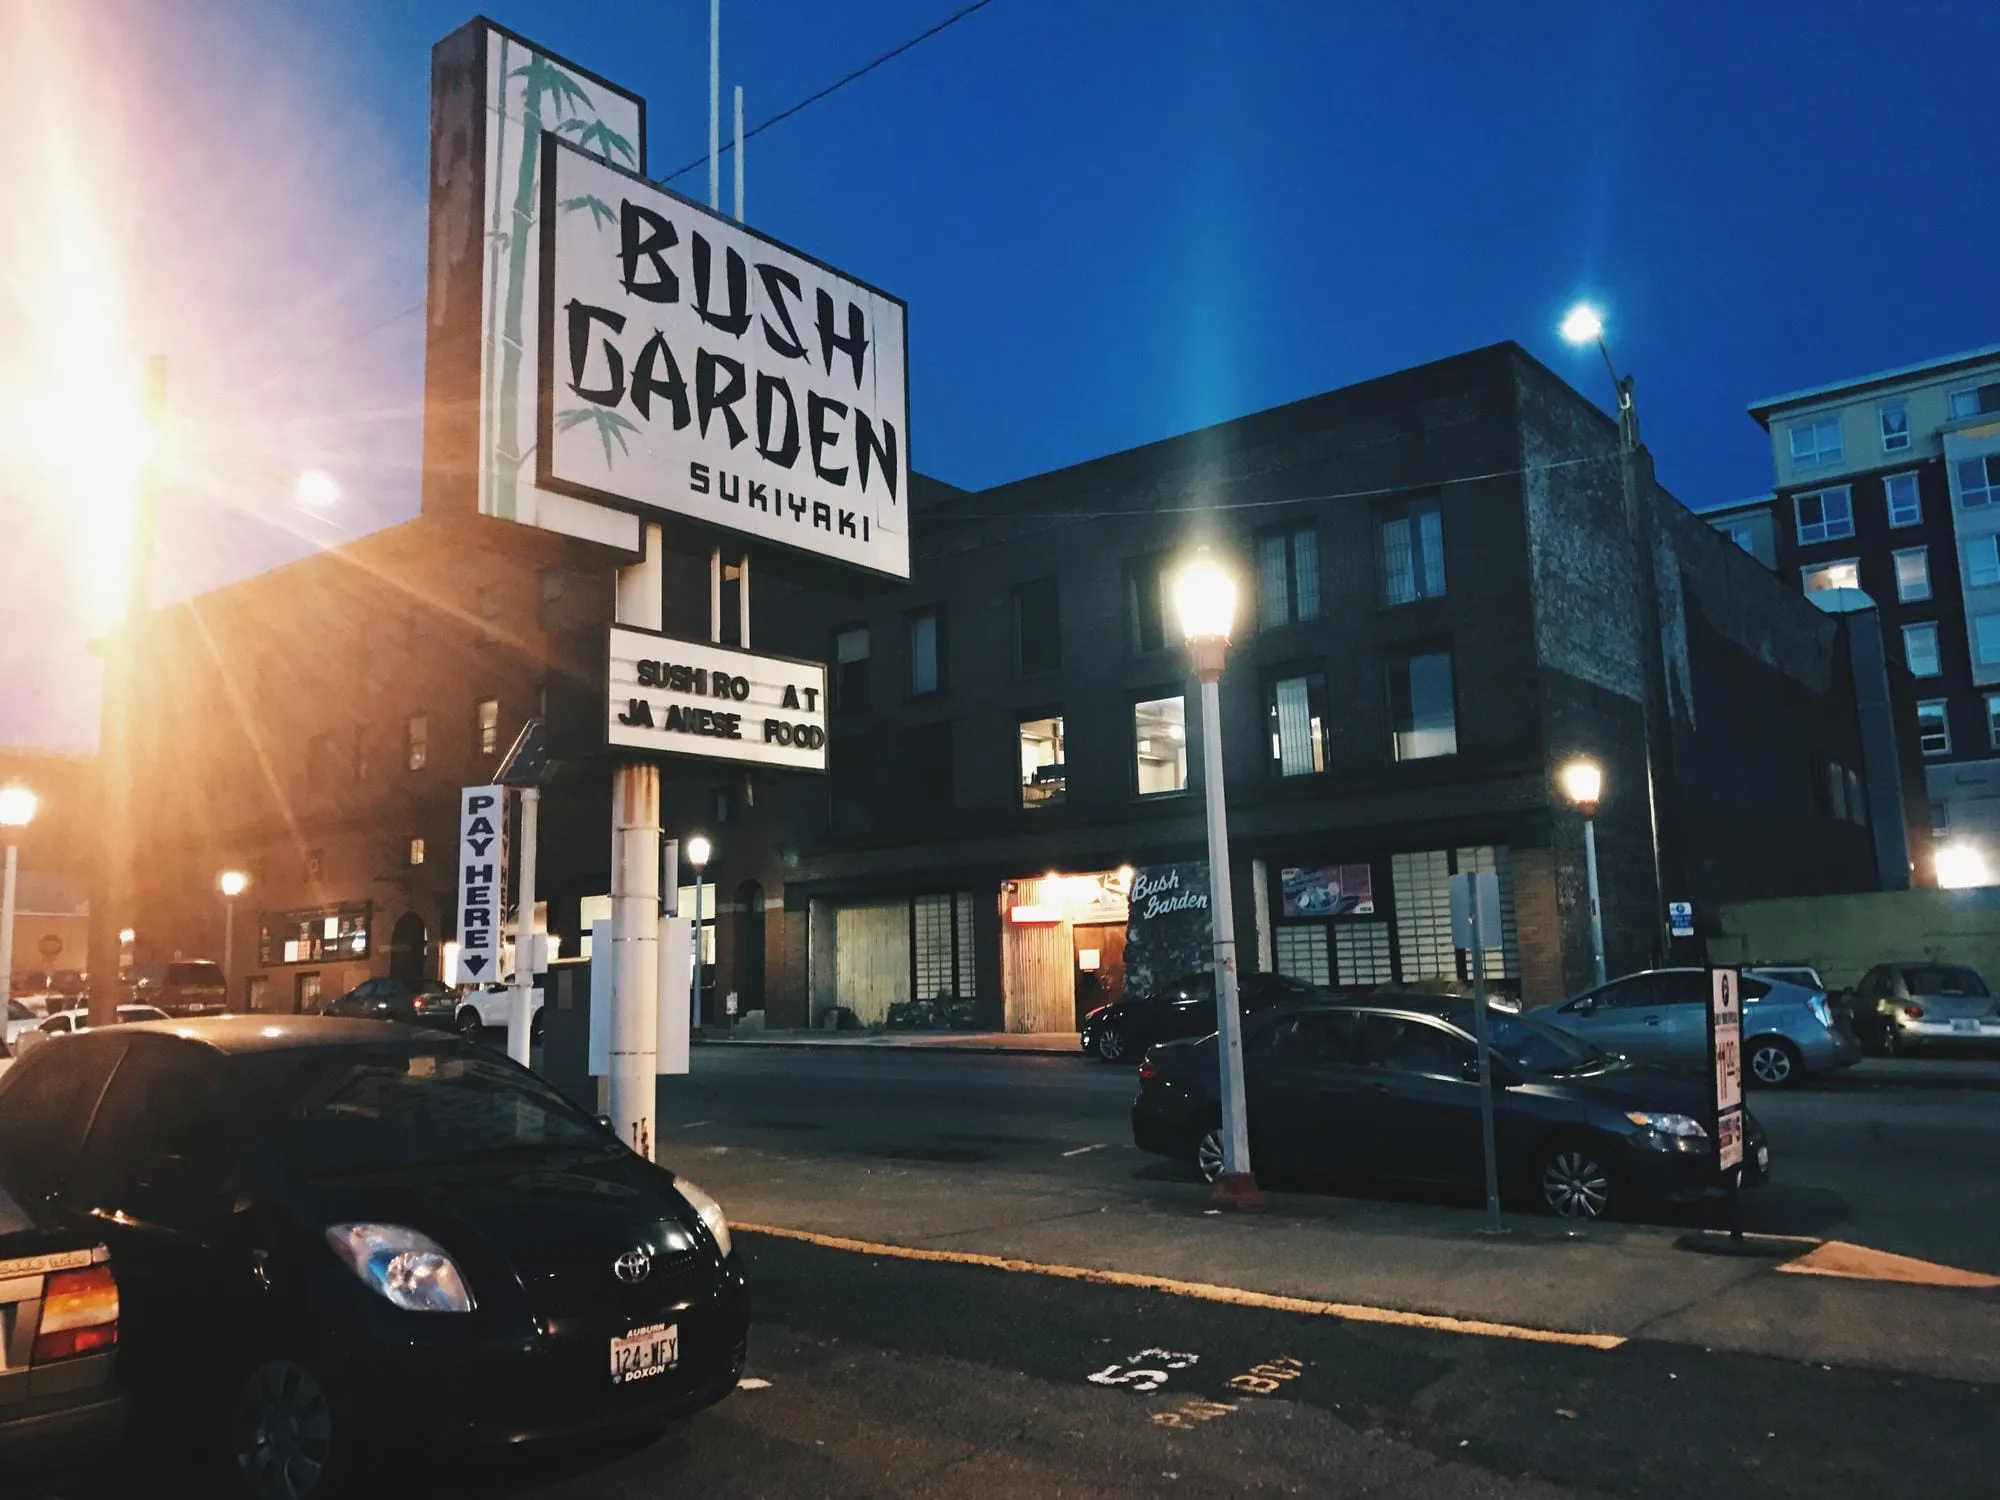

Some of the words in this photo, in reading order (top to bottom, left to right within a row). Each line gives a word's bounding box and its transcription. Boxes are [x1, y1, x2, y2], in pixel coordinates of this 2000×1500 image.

[616, 198, 869, 390] BUSH
[564, 298, 898, 505] GARDEN
[690, 461, 869, 541] SUKIYAKI
[764, 718, 825, 750] FOOD
[466, 795, 494, 857] PAY
[464, 864, 493, 949] HERE
[1132, 869, 1179, 903] Bush
[1143, 890, 1207, 920] Garden
[626, 1323, 666, 1338] AUBURN
[625, 1364, 665, 1382] DOXON
